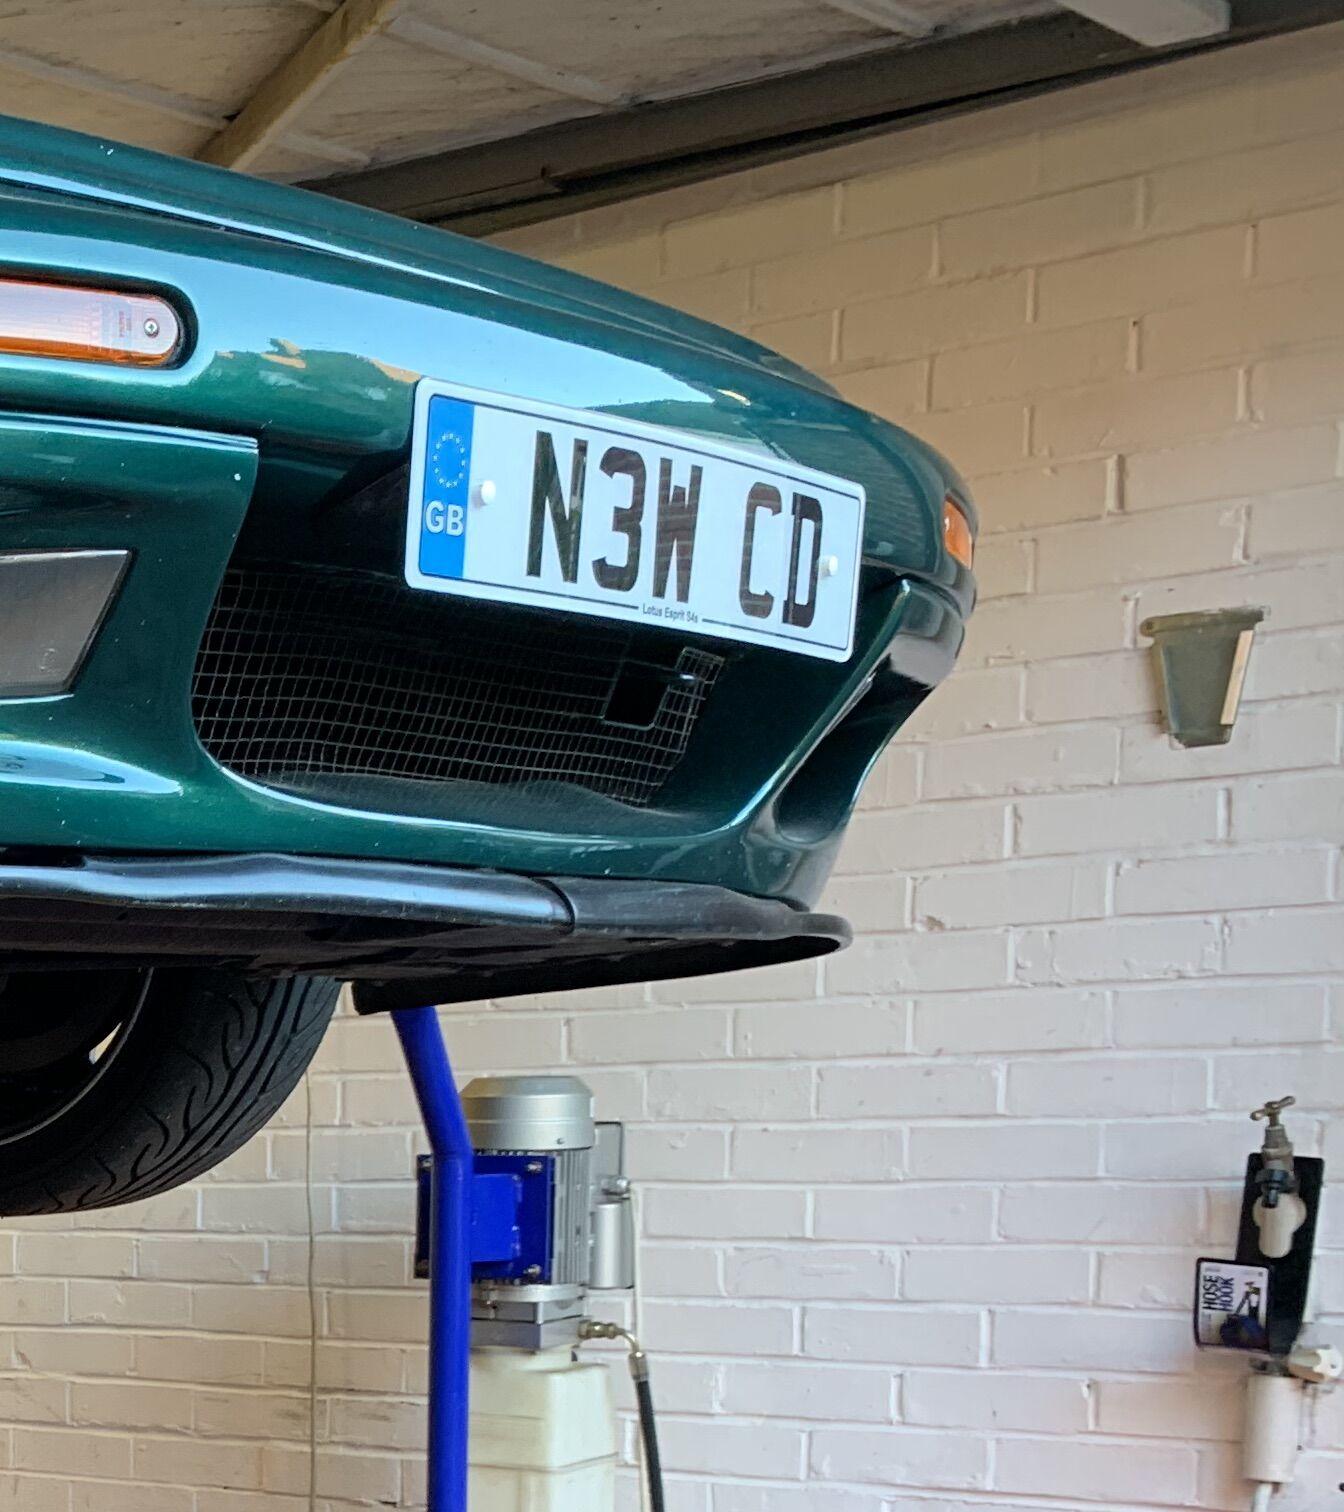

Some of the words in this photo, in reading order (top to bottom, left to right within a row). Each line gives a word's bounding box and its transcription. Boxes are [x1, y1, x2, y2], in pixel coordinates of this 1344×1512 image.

[425, 500, 465, 537] GB
[525, 430, 703, 604] N3W
[738, 481, 824, 629] CD
[642, 603, 663, 617] Lotus
[664, 606, 685, 622] Esprit
[1202, 1275, 1219, 1310] HOSE
[1216, 1277, 1234, 1312] HOOK
